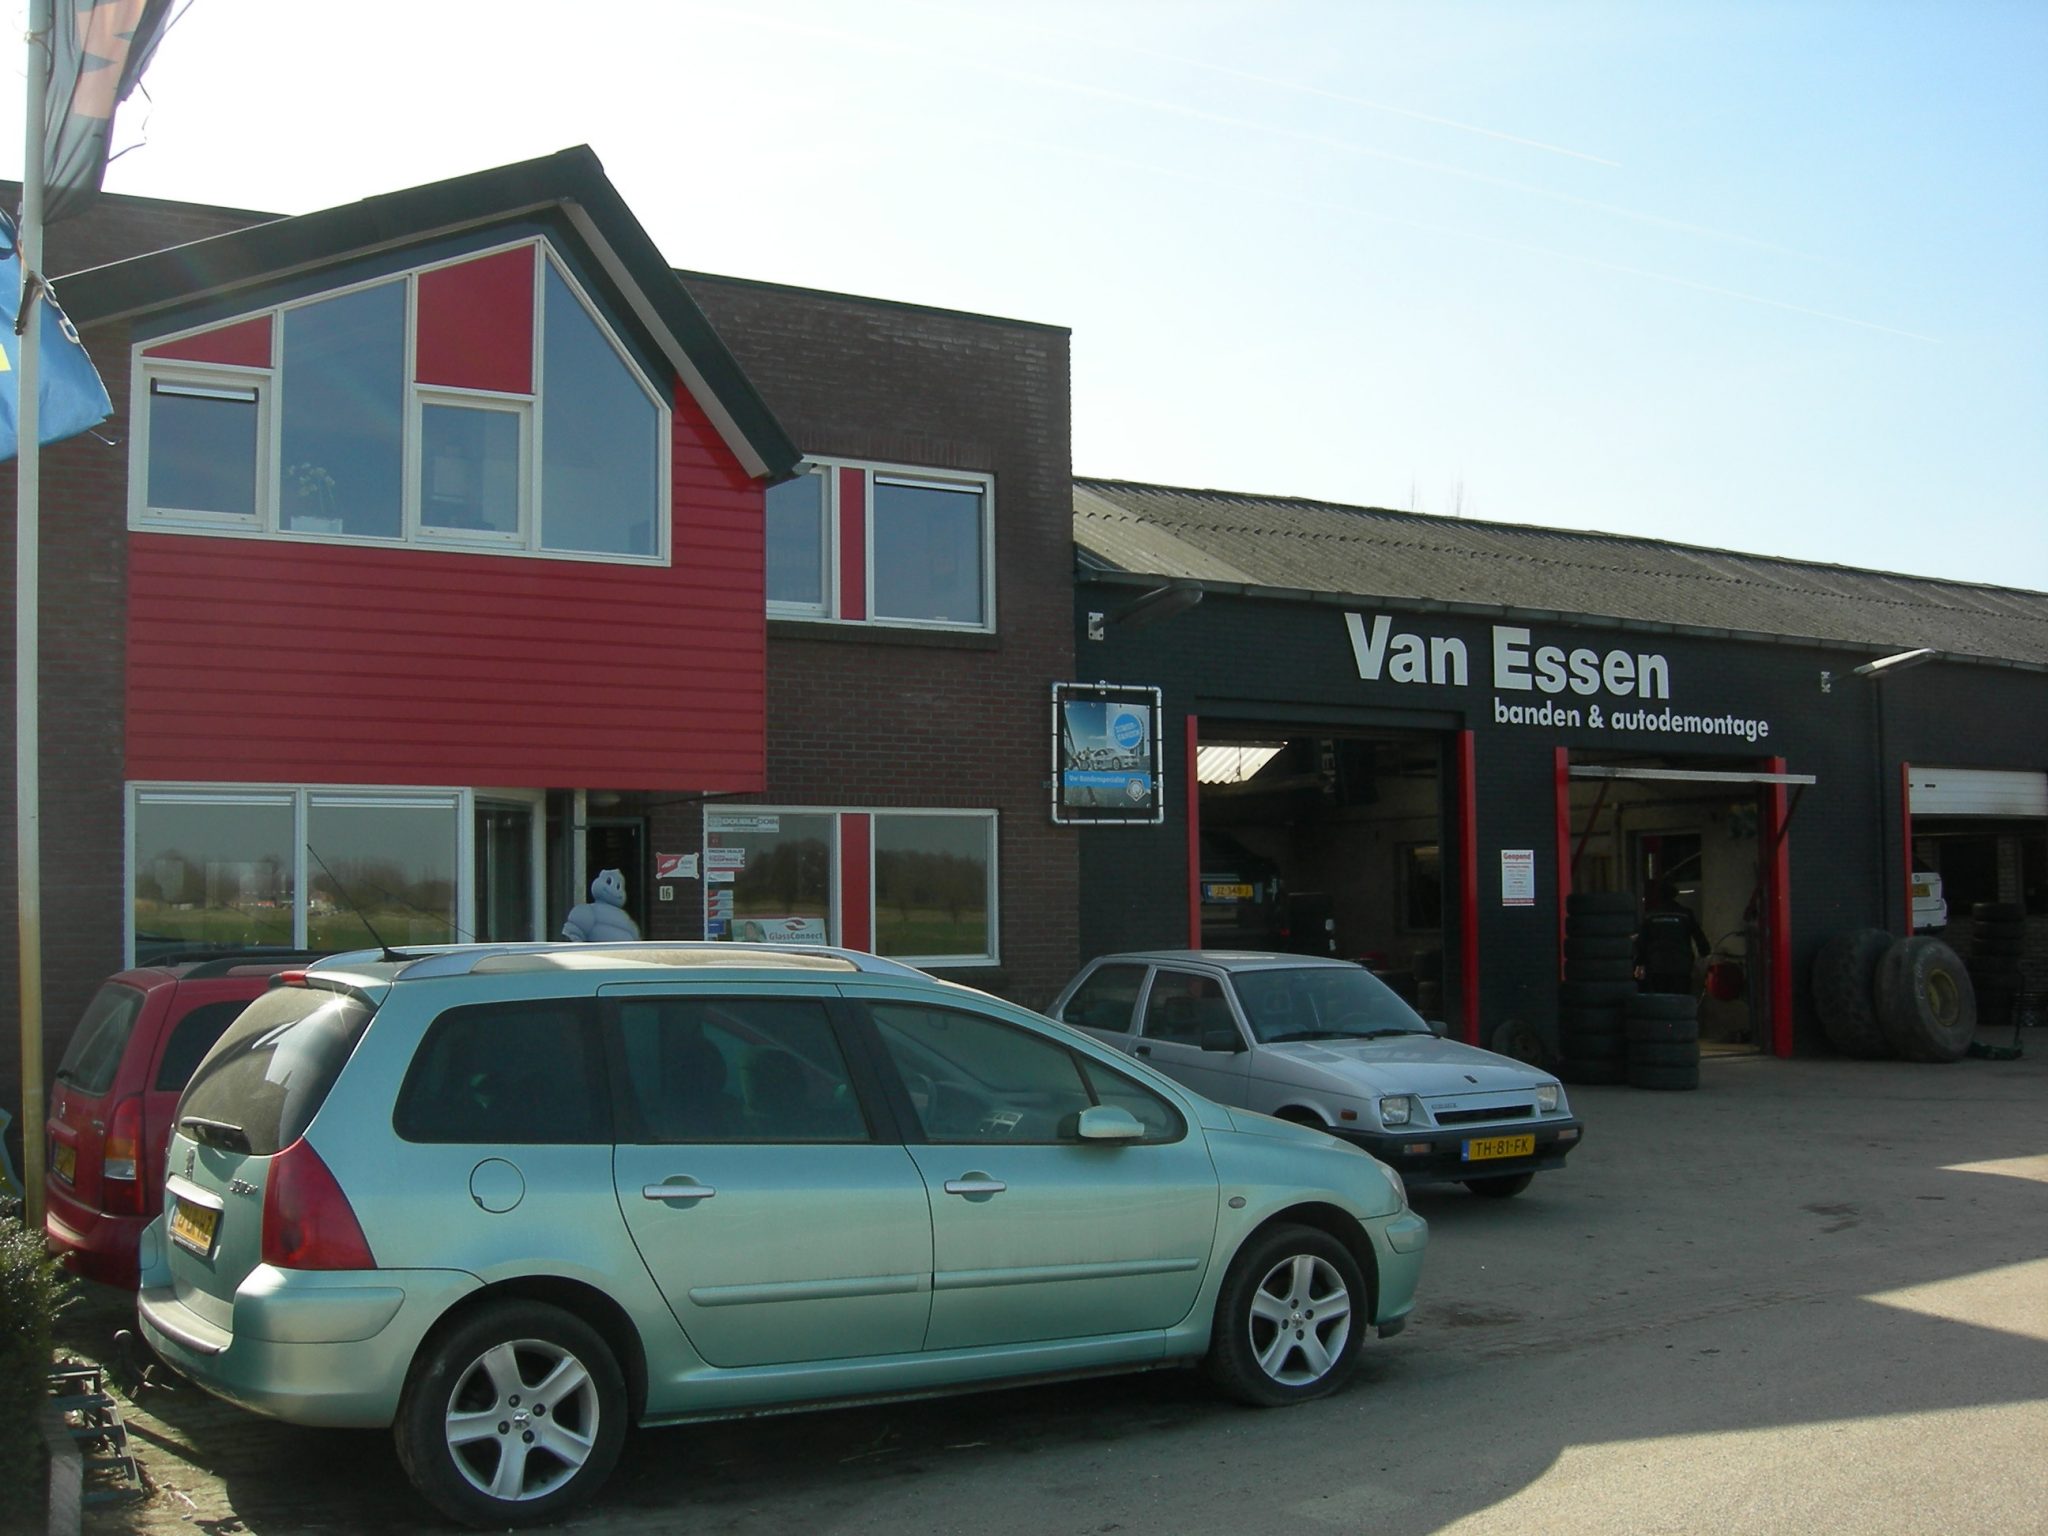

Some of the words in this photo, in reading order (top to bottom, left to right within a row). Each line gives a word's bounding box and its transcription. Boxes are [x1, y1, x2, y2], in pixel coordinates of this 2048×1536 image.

[1344, 612, 1468, 686] Van
[1493, 625, 1669, 699] Essen
[1494, 697, 1581, 728] banden
[1588, 704, 1604, 729] &
[1611, 707, 1769, 742] autodemontage
[662, 887, 671, 900] 16
[1475, 1137, 1529, 1156] TH-81-FK
